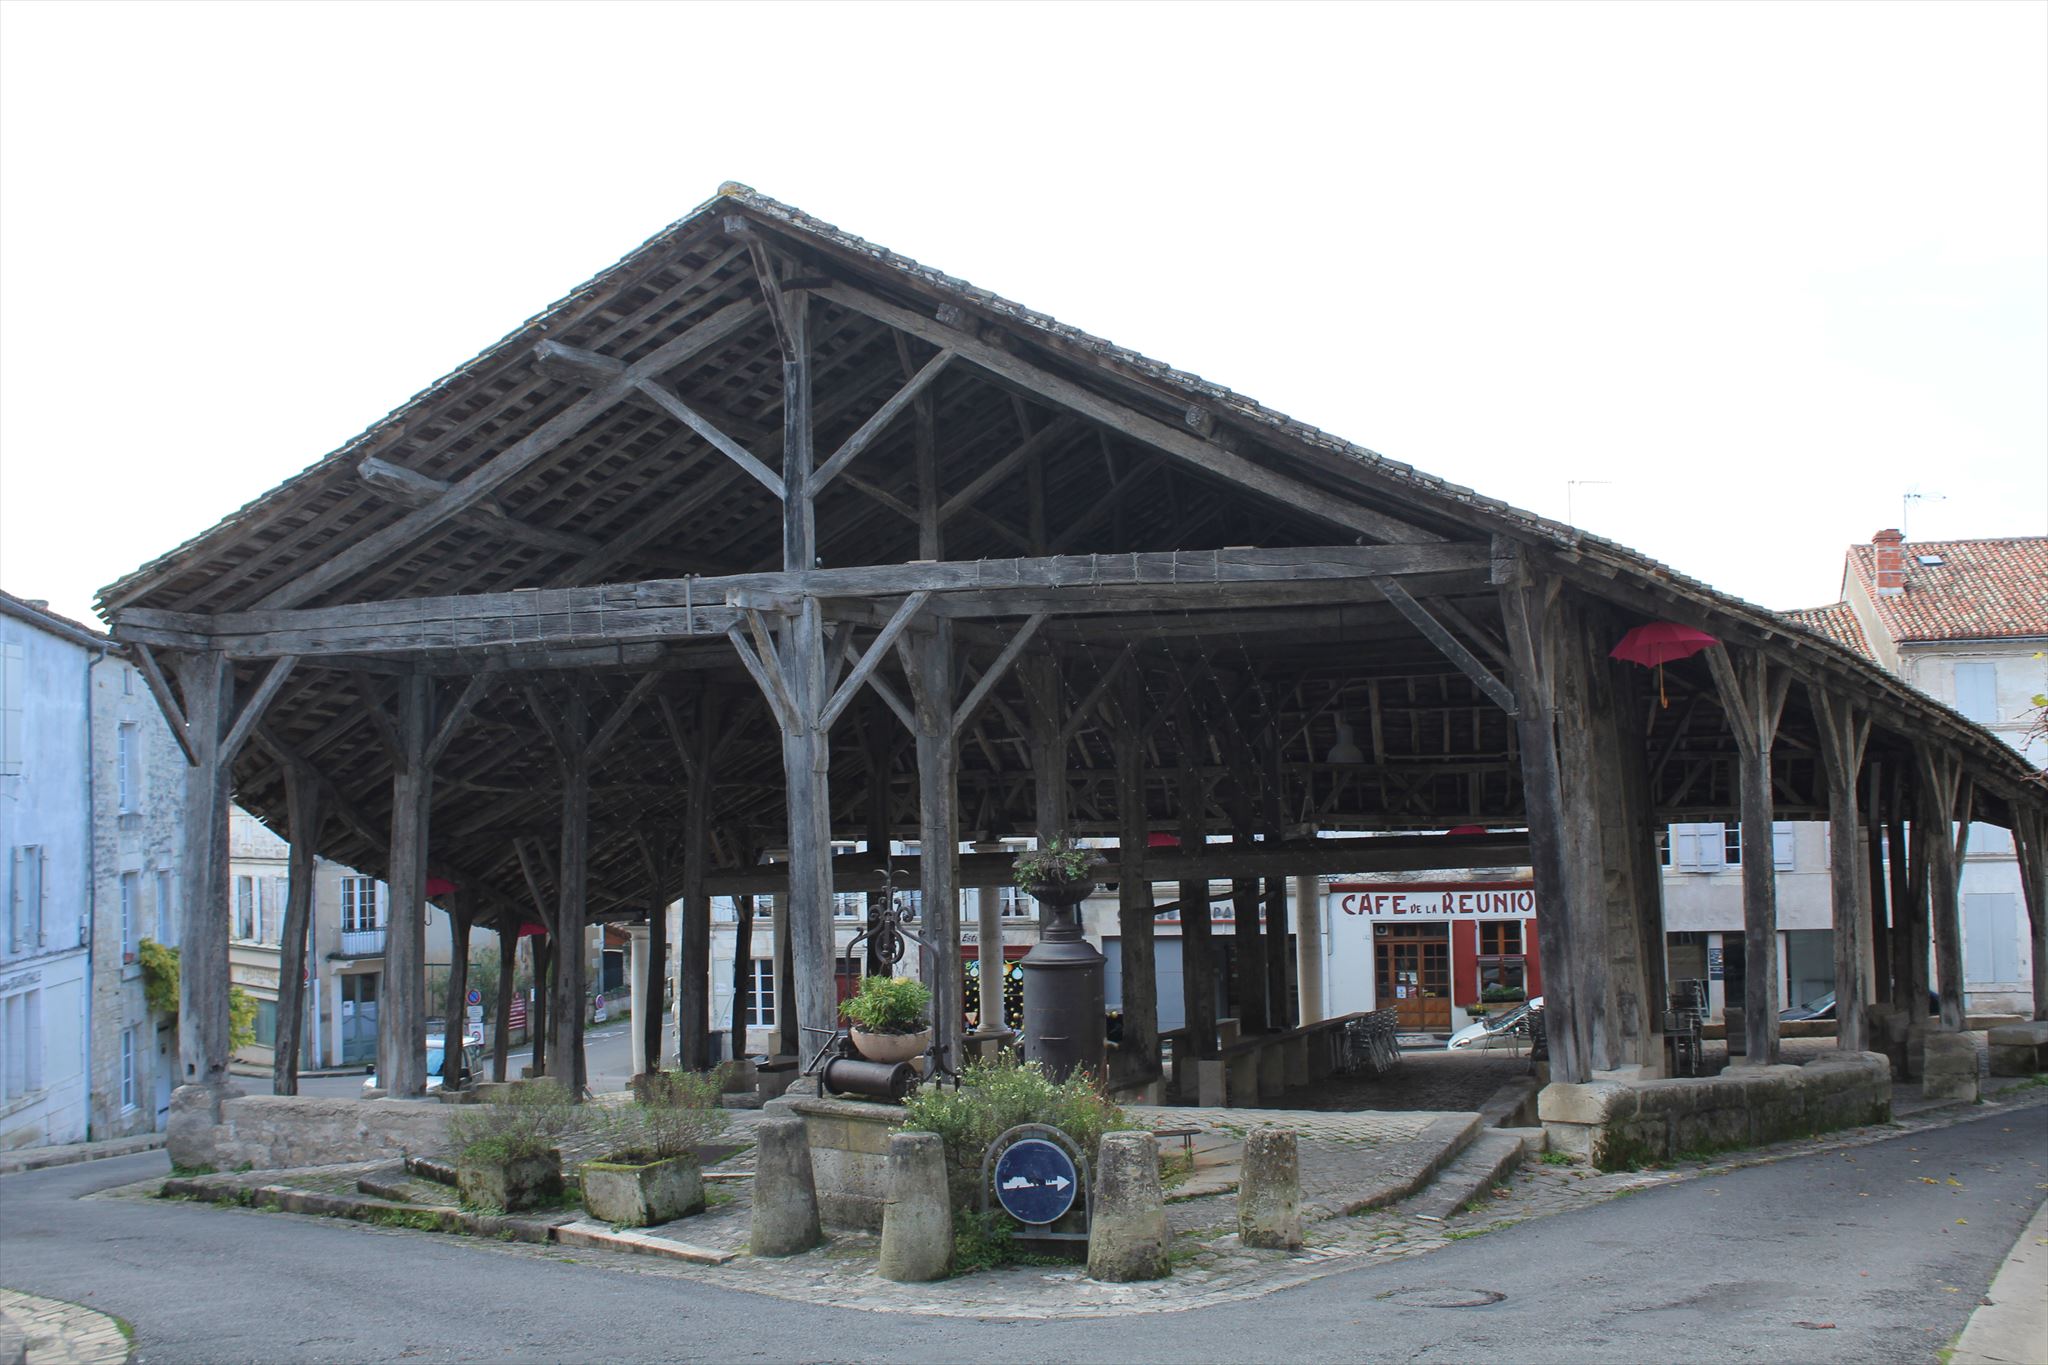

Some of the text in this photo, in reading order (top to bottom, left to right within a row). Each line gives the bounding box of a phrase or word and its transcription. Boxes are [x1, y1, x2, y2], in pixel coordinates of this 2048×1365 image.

[1342, 891, 1534, 915] CAFE DE LA REUNIO
